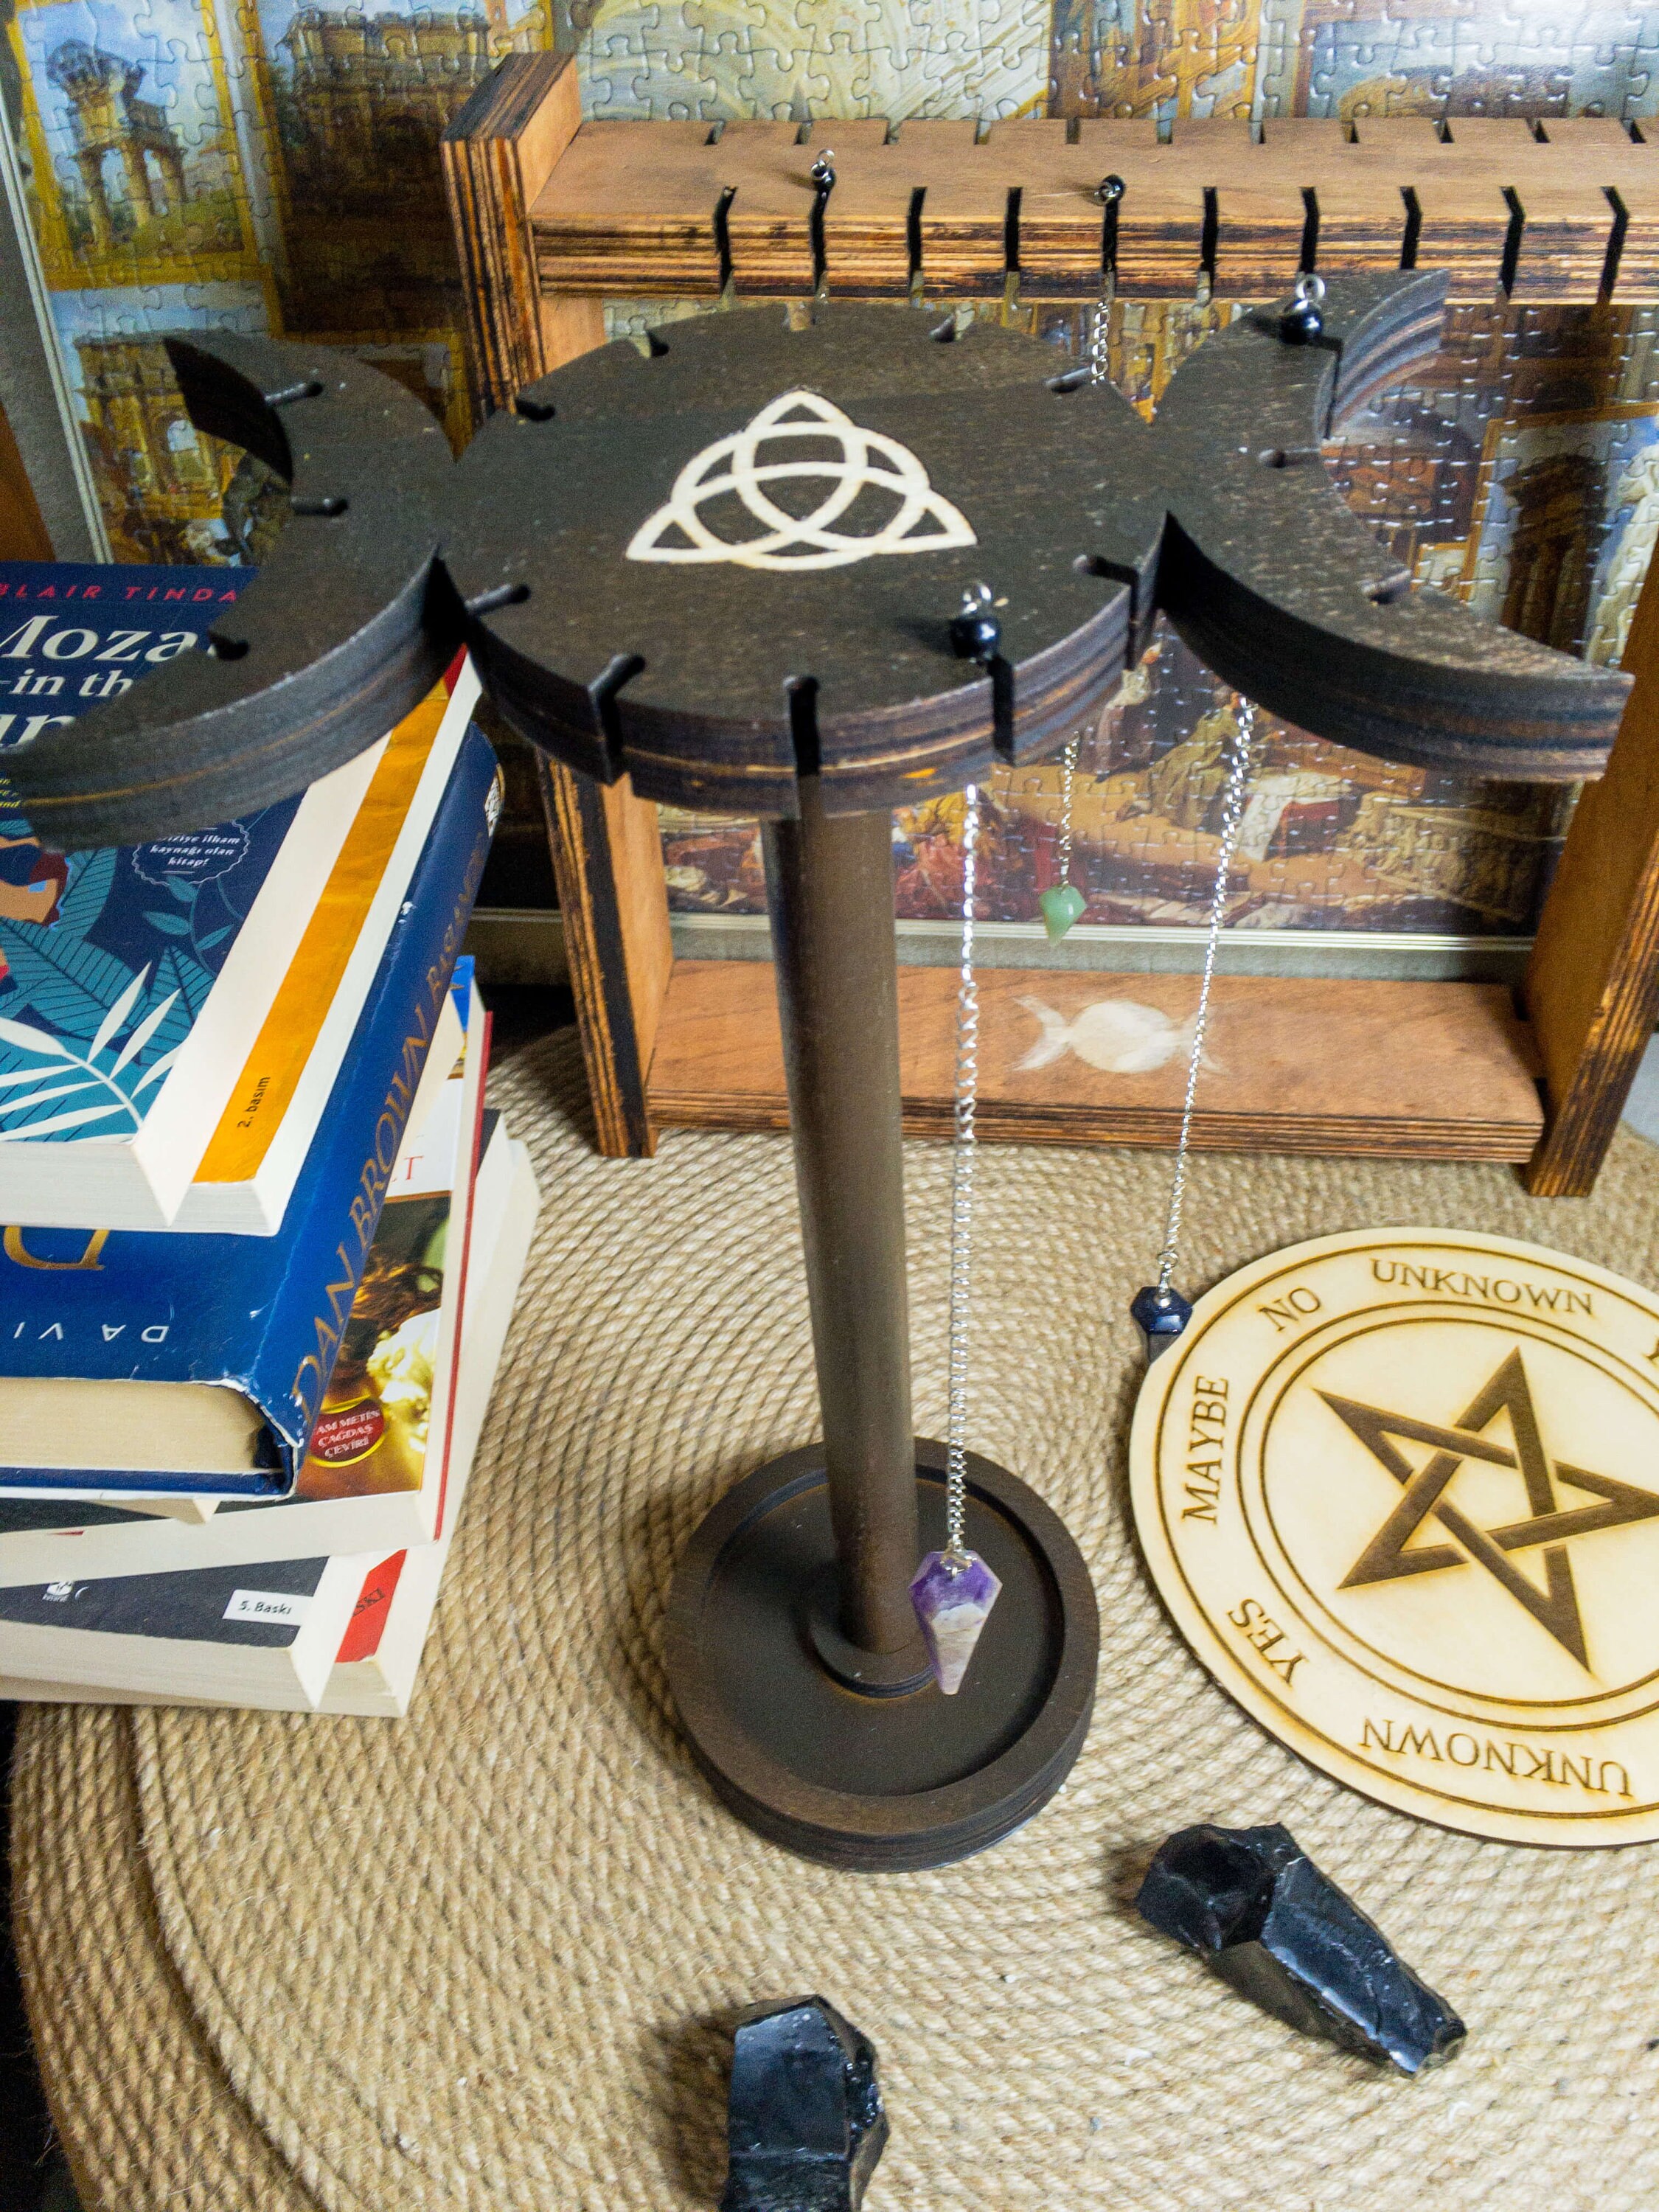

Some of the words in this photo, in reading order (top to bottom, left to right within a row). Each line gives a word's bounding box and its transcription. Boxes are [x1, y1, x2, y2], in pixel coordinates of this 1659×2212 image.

[150, 844, 201, 856] kaynağı
[204, 846, 234, 855] olan
[202, 835, 240, 844] ilham
[167, 857, 210, 868] kitap!
[243, 1077, 271, 1112] basım
[236, 1116, 254, 1128] 2.
[293, 1242, 355, 1423] DAN
[349, 1004, 428, 1251] BROWN
[1368, 1258, 1595, 1316] UNKNOWN
[1258, 1286, 1321, 1332] NO
[1181, 1375, 1229, 1525] MAYBE
[238, 1599, 251, 1611] 5.
[1227, 1599, 1310, 1687] YES
[1358, 1717, 1632, 1798] UNKNOWN
